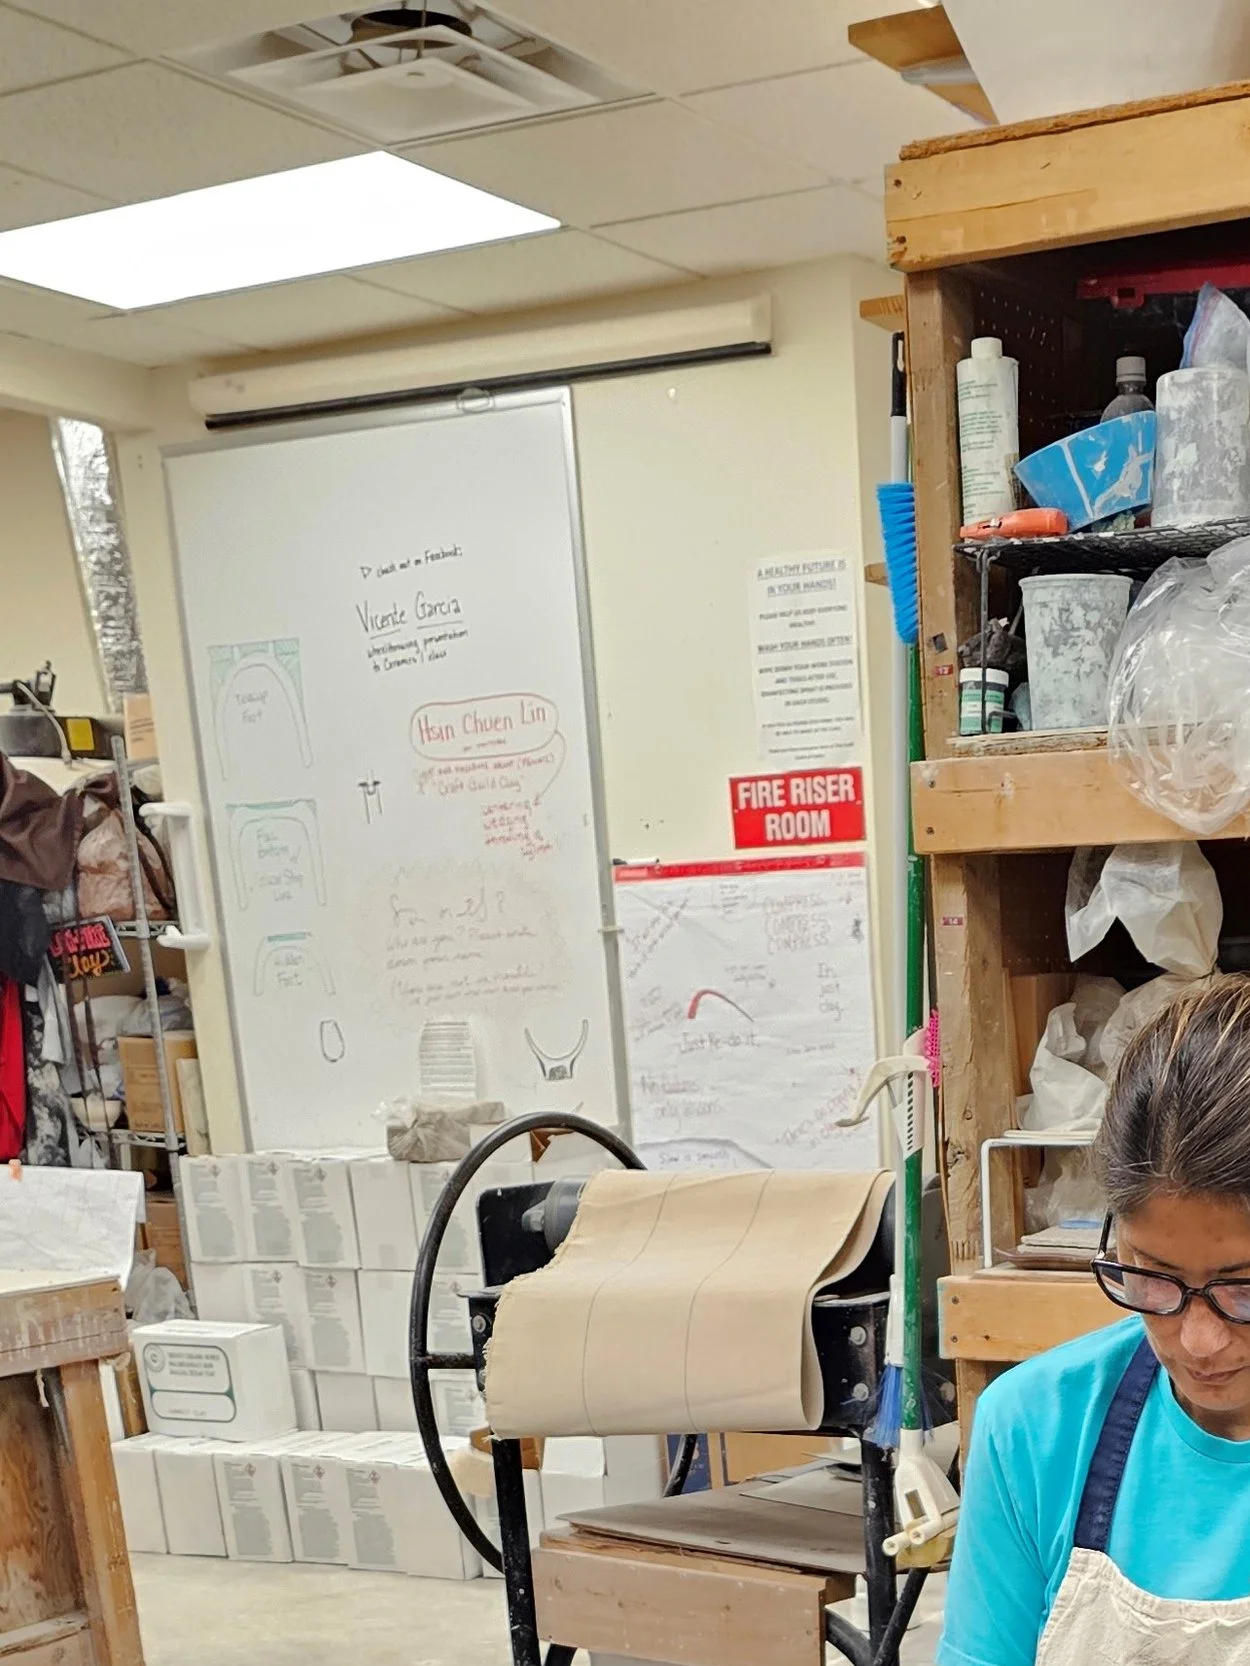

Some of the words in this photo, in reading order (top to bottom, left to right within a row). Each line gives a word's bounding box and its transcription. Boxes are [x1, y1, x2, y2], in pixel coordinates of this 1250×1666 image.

[765, 564, 800, 577] HEALTHY
[802, 559, 835, 574] FUTURE
[778, 581, 800, 594] YOUR
[355, 599, 408, 634] Vicente
[415, 590, 462, 621] Garcia
[417, 714, 456, 746] Hsin
[462, 710, 514, 735] Chuen
[520, 700, 547, 726] Lin
[737, 778, 785, 810] FIRE
[789, 773, 855, 805] RISER
[764, 809, 831, 841] ROOM
